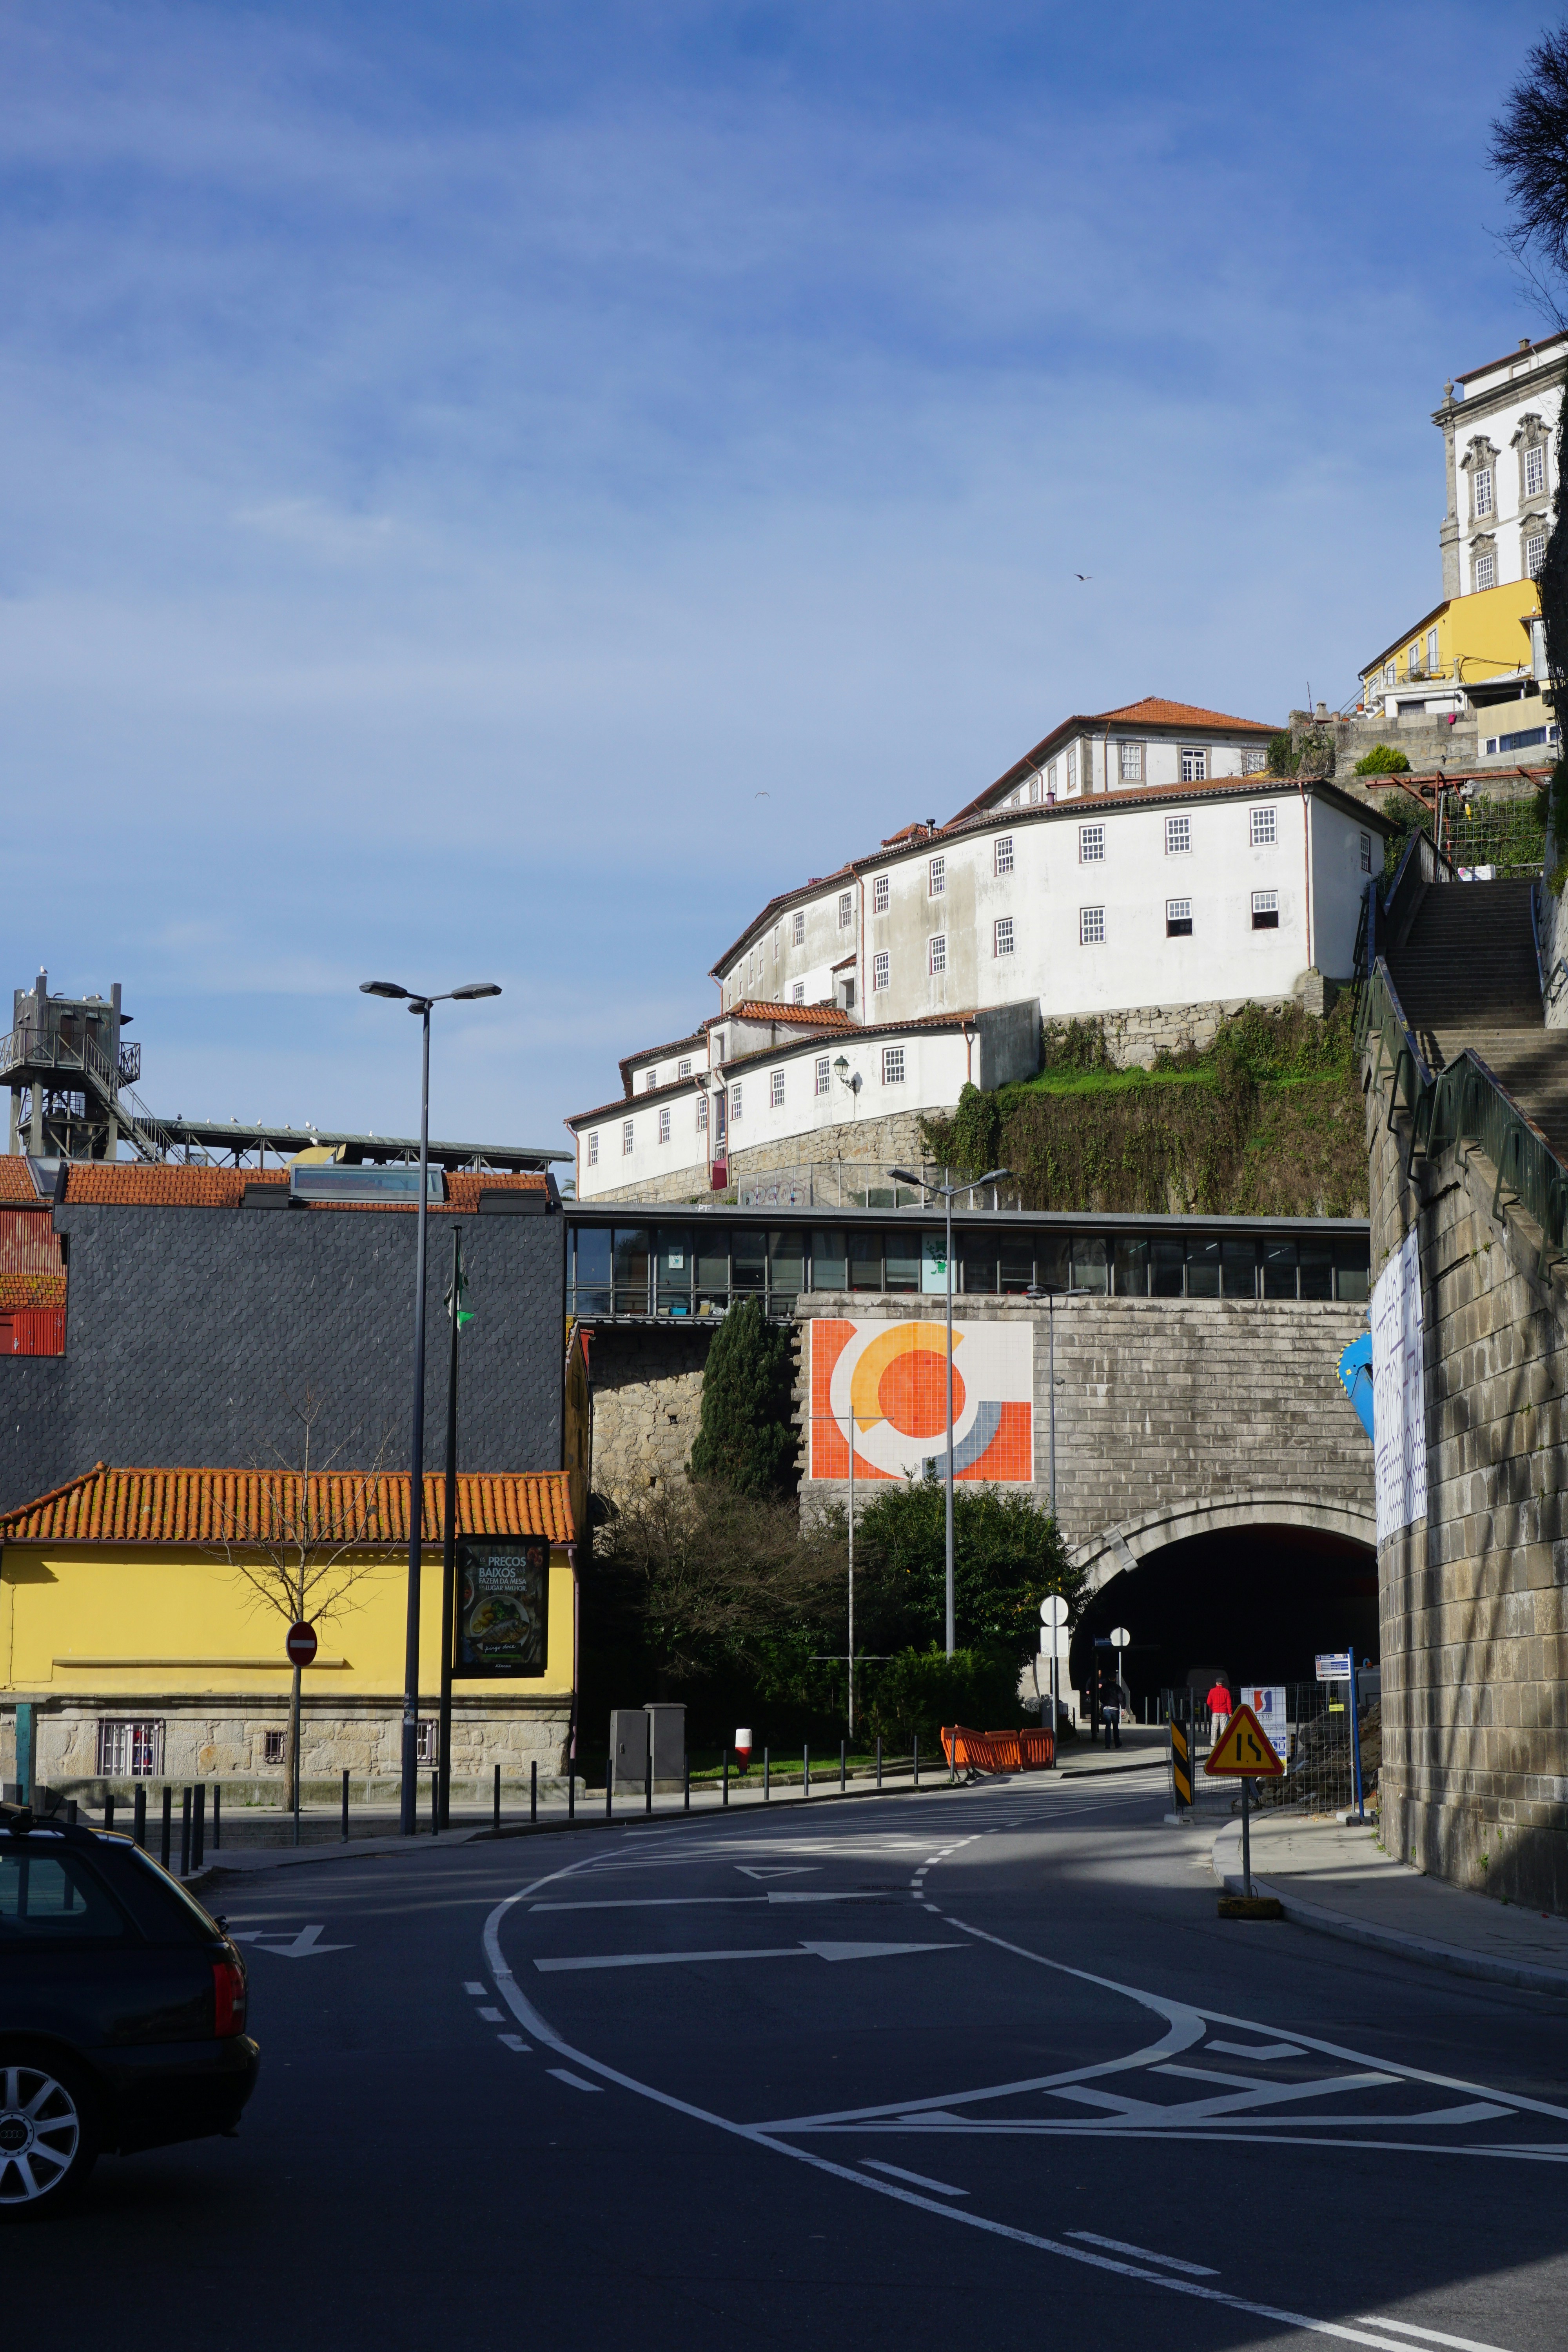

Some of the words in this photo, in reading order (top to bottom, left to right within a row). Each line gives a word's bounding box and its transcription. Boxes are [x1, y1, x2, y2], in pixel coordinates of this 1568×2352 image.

[488, 1557, 526, 1568] PREÇOS
[479, 1568, 516, 1578] BAIXOS
[485, 1645, 501, 1653] pingo
